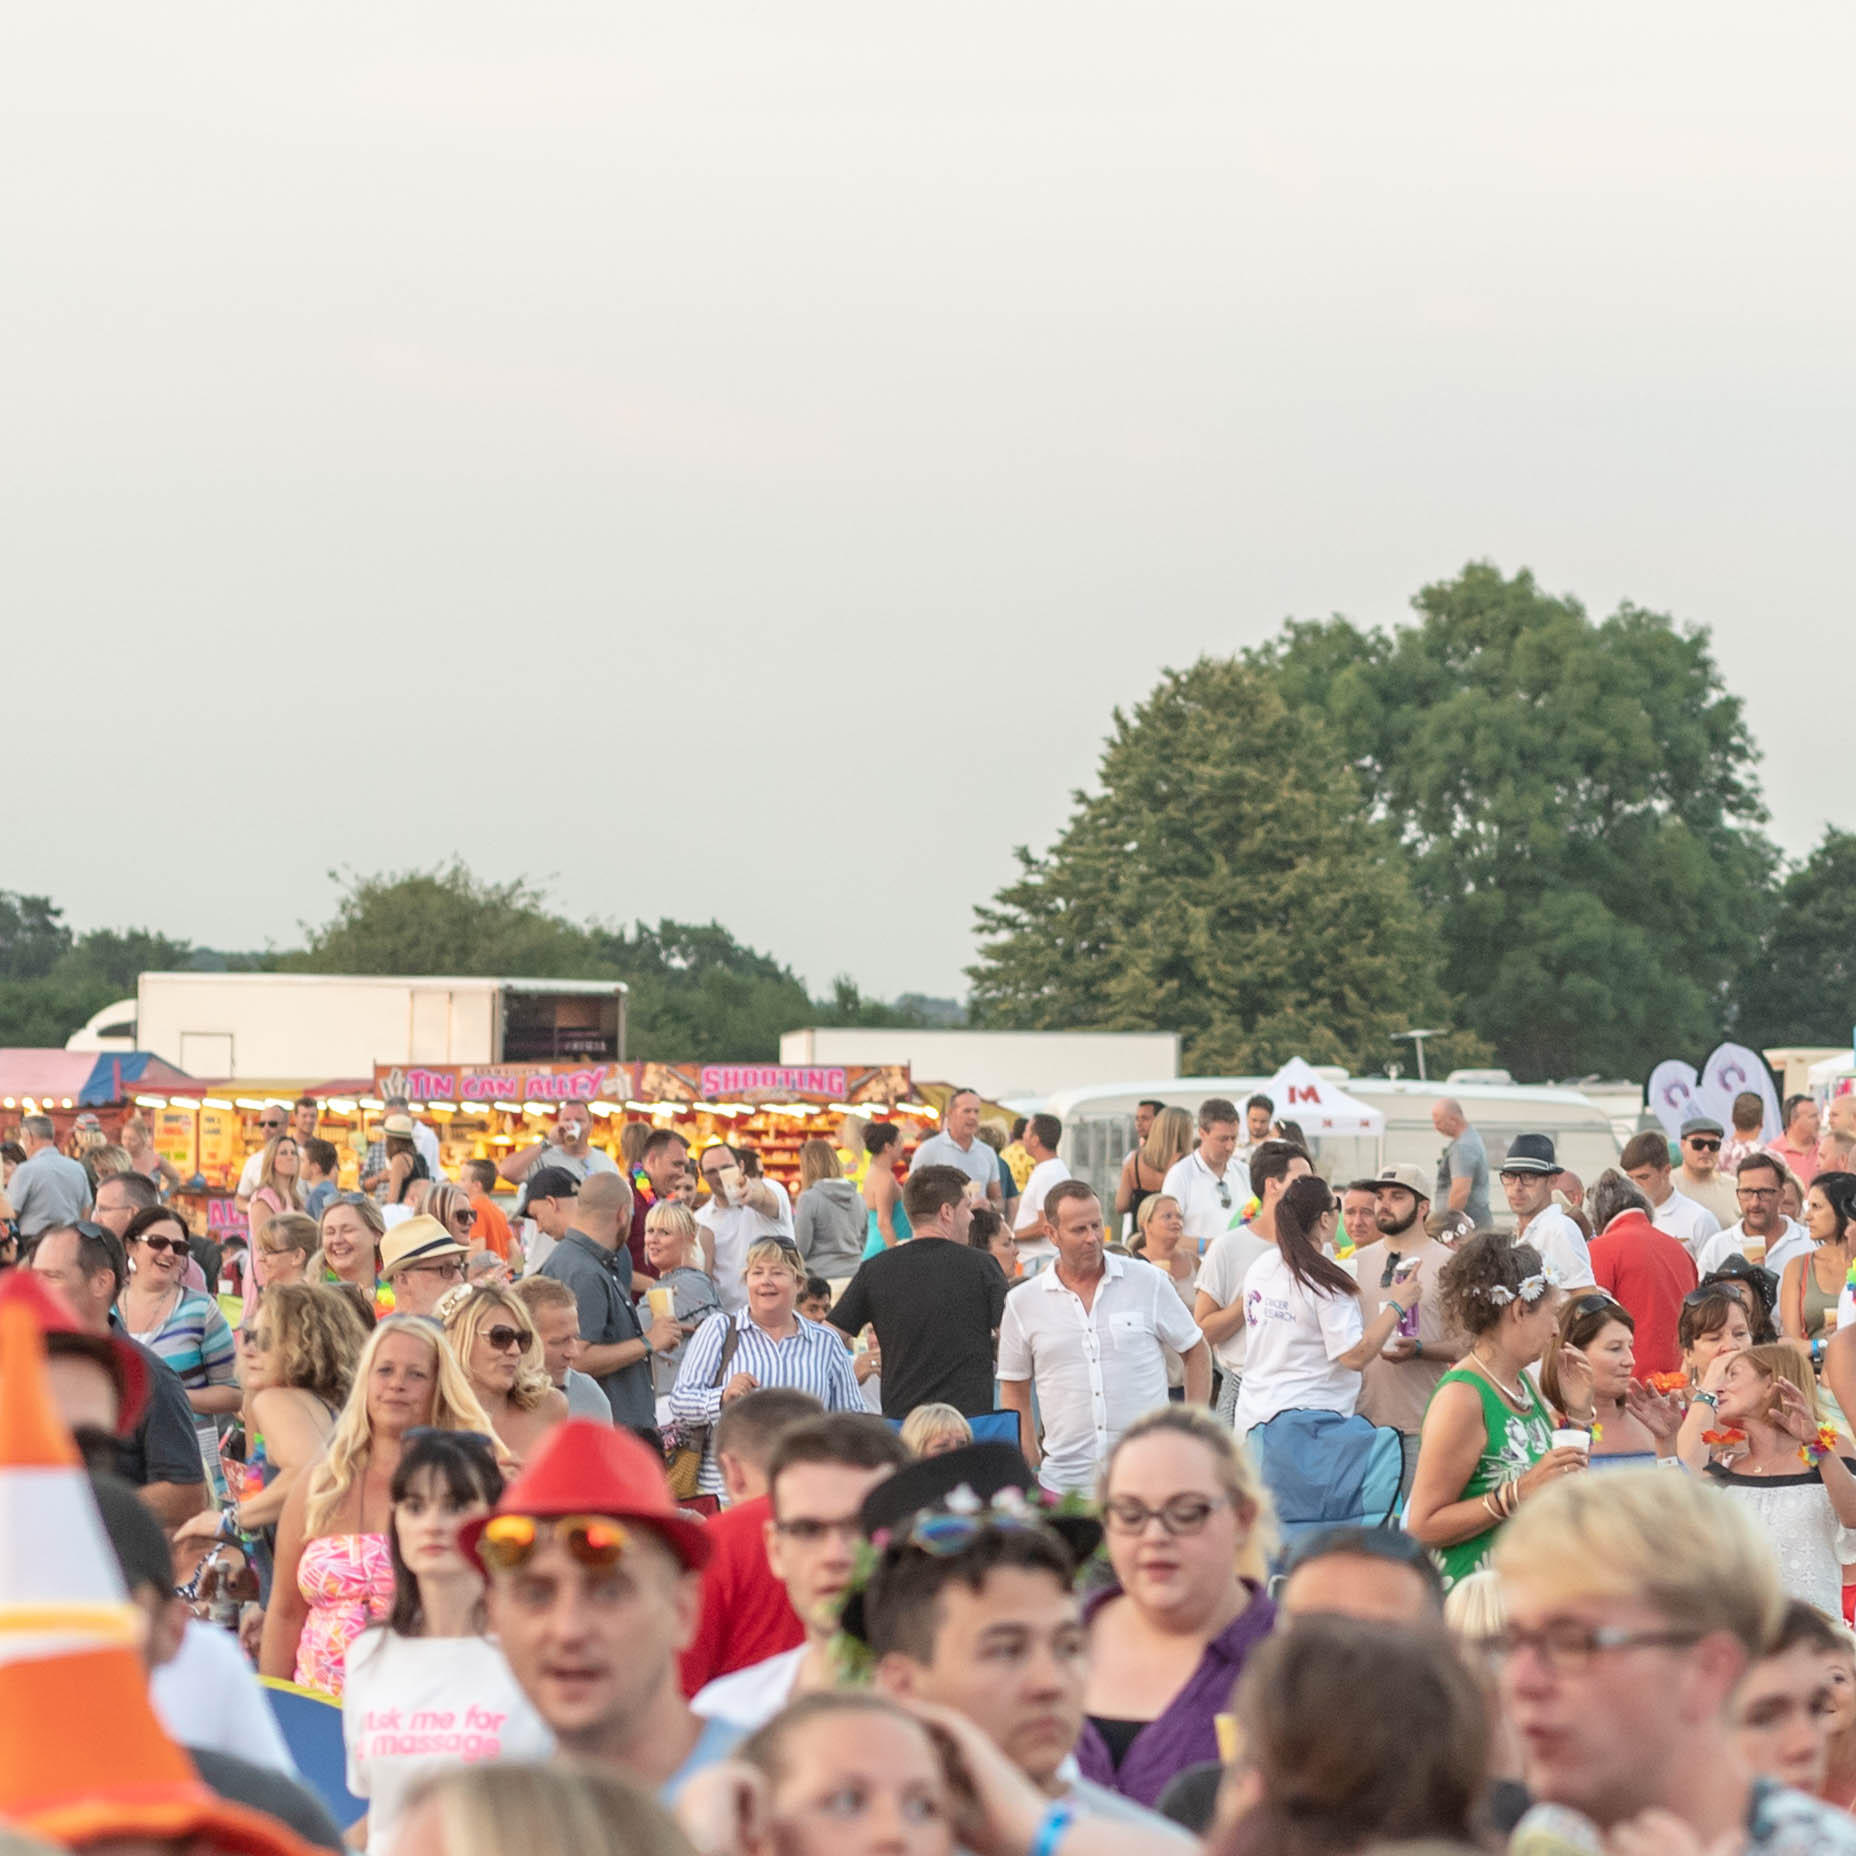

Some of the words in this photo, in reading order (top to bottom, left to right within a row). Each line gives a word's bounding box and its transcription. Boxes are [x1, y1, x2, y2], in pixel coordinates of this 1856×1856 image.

[408, 1069, 454, 1099] TIN
[460, 1075, 517, 1099] CAN
[525, 1065, 608, 1099] ALLEY
[702, 1066, 846, 1098] SHOOTING
[408, 1711, 456, 1731] me
[464, 1704, 507, 1732] for
[372, 1733, 502, 1764] massage
